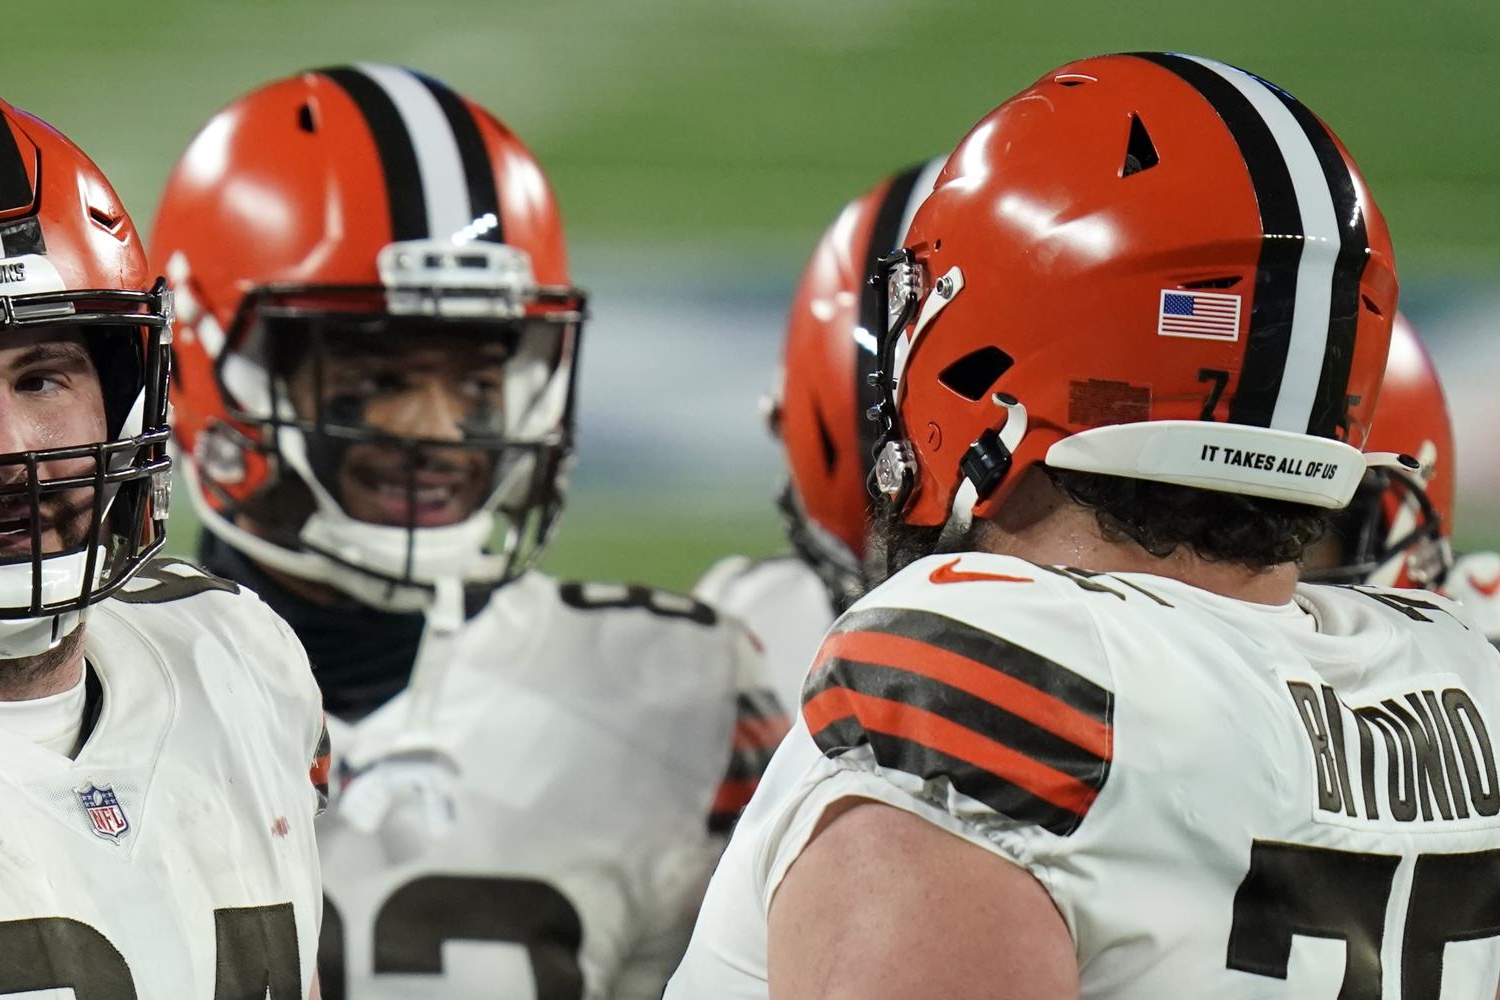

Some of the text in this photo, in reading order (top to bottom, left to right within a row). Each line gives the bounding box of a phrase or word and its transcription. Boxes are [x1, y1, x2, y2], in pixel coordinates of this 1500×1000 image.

[1201, 444, 1338, 480] IT TAKES ALL OF US
[89, 807, 125, 832] NFL
